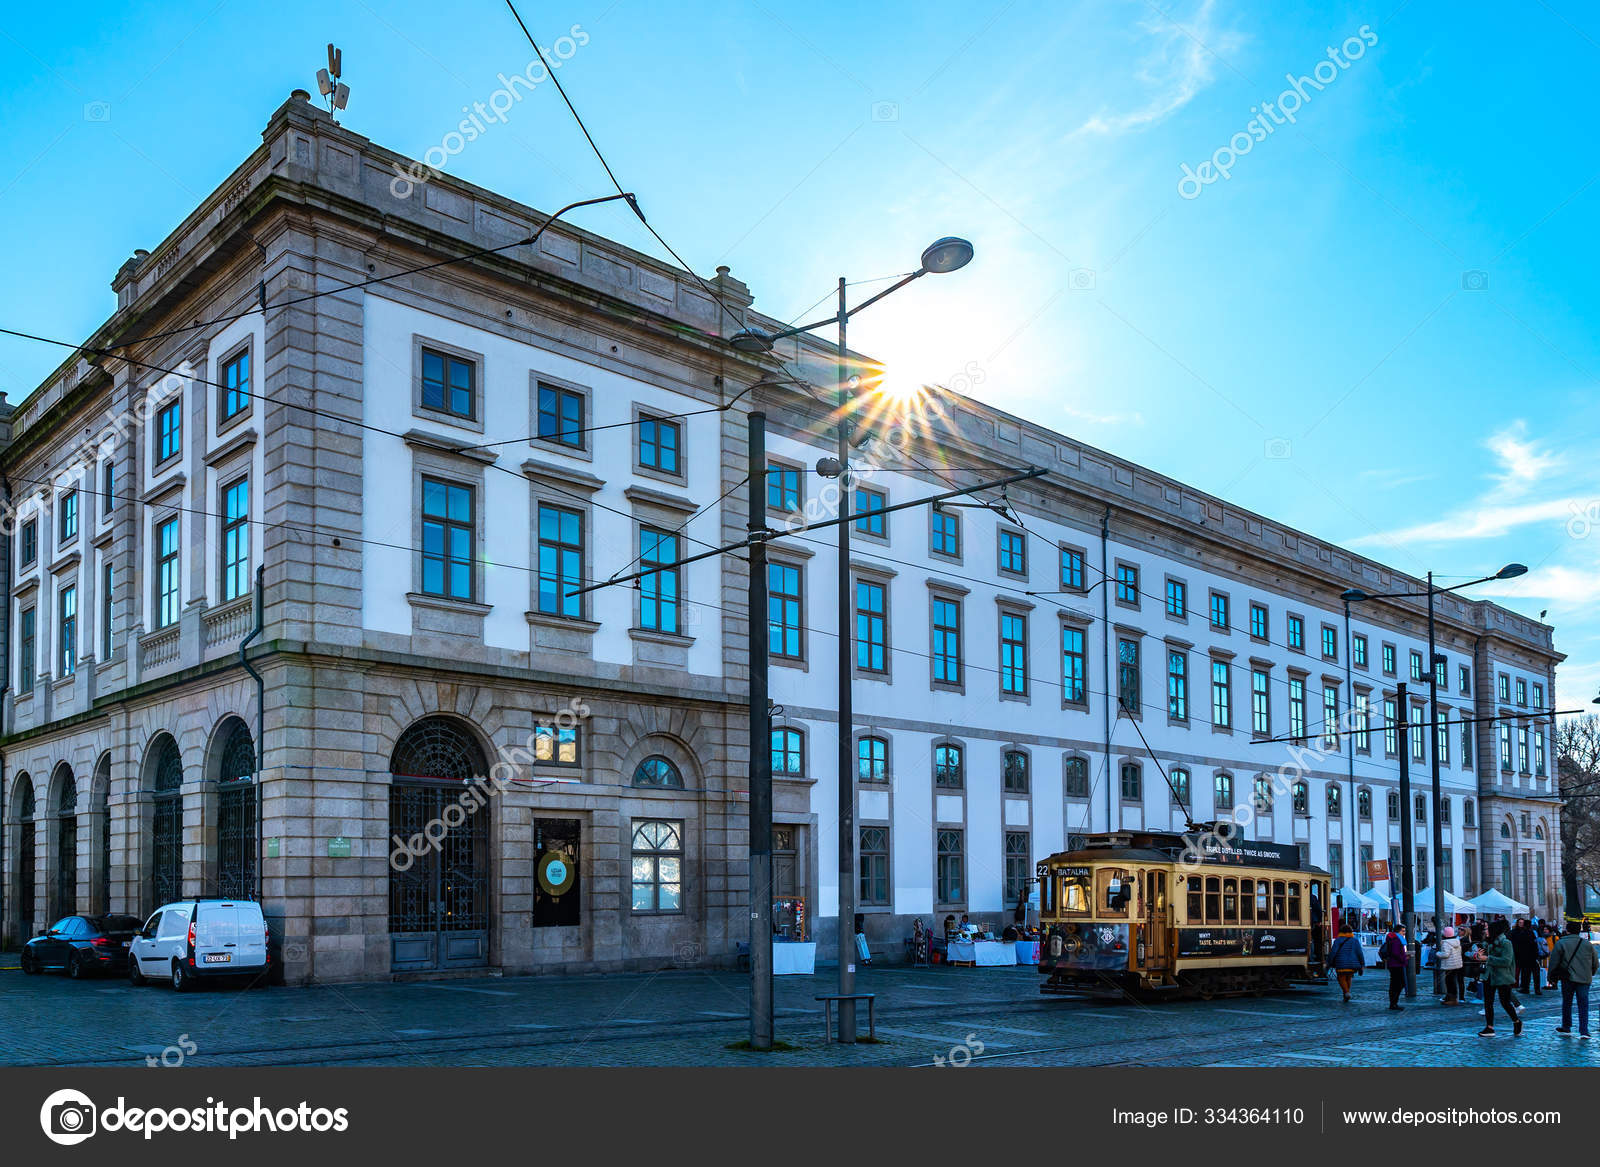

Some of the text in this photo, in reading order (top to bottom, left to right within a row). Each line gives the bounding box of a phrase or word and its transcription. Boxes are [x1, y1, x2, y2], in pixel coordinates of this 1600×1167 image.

[1244, 849, 1257, 857] TWICE
[1037, 865, 1048, 876] 22
[1057, 868, 1089, 876] BATALHA
